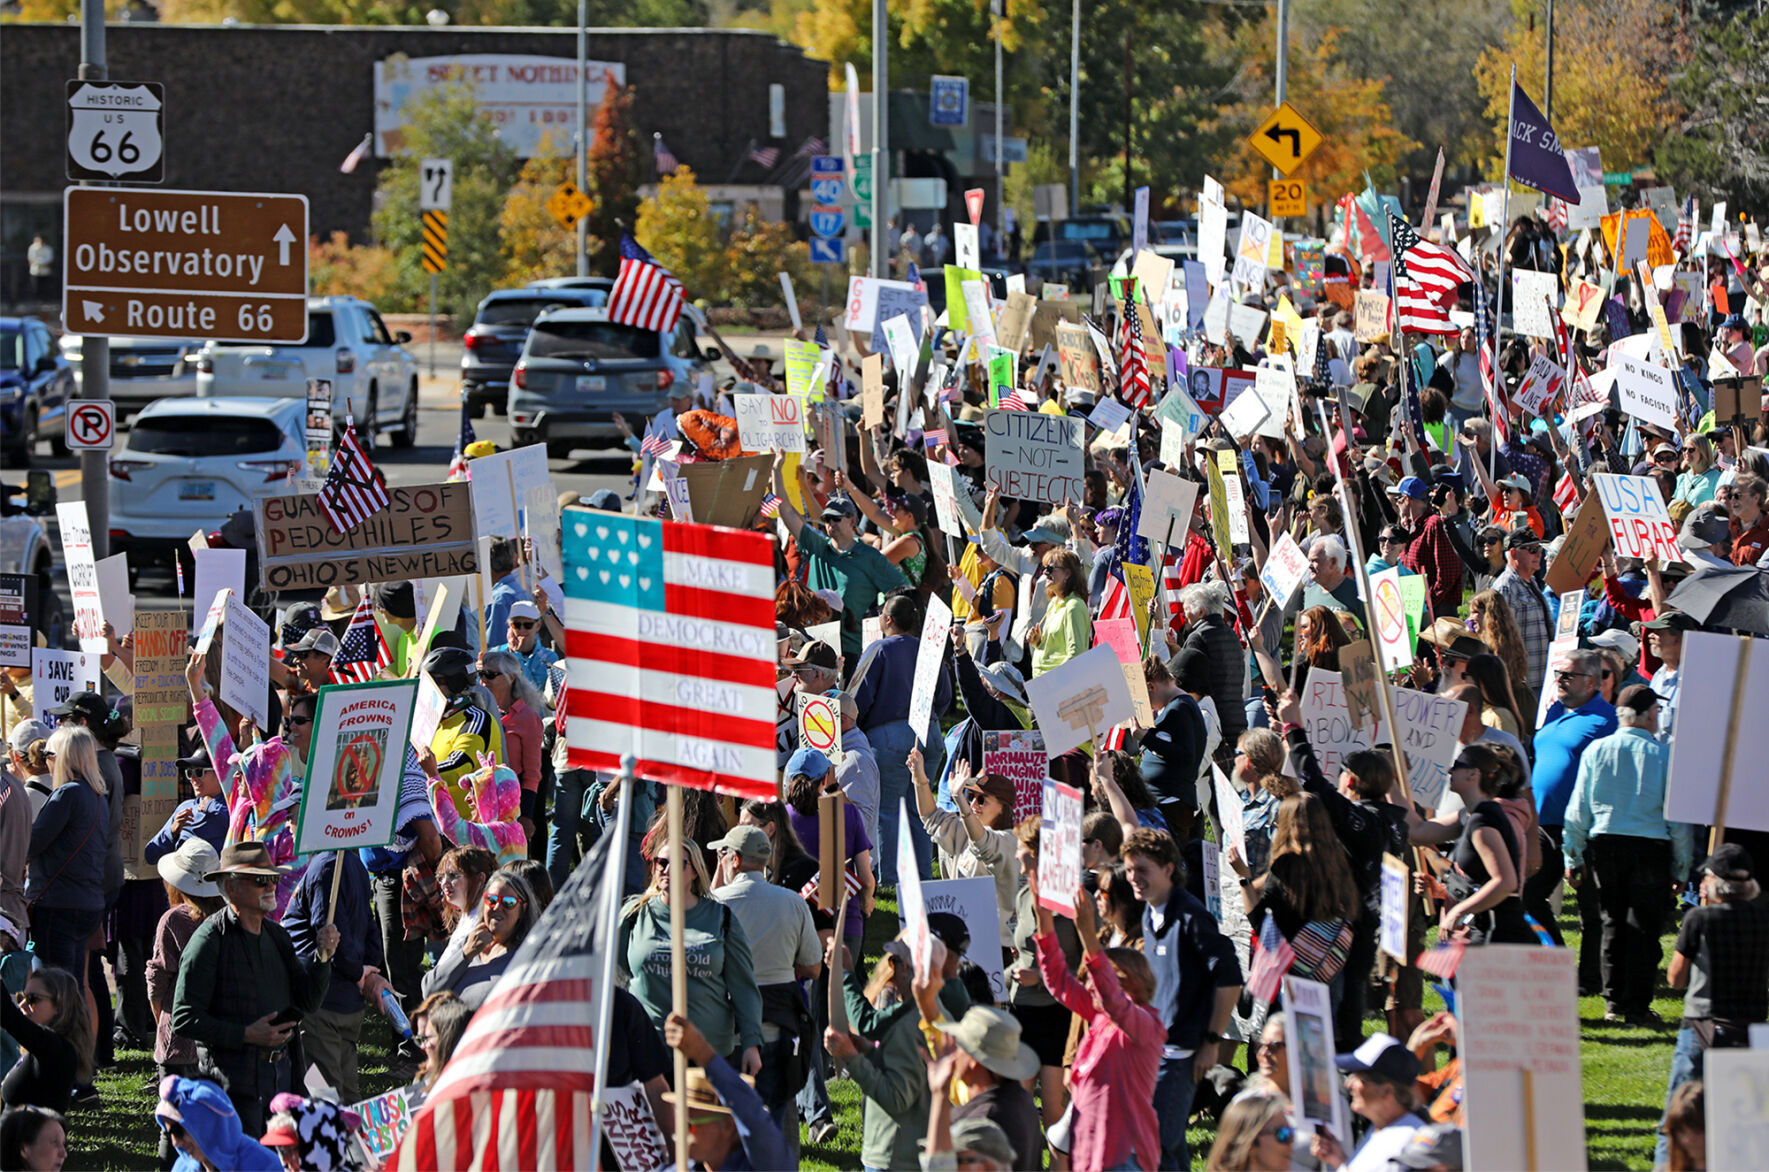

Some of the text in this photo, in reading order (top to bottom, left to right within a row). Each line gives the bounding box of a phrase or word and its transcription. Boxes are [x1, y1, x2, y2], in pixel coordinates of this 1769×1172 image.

[87, 95, 144, 107] HISTORIC
[1512, 119, 1538, 143] ACK
[90, 130, 140, 164] 66
[813, 184, 842, 201] 40
[1273, 183, 1302, 200] 20
[119, 204, 221, 235] Lowell
[818, 213, 836, 230] 17
[76, 243, 264, 285] Observatory
[127, 301, 274, 332] Route 66
[1532, 357, 1551, 380] HOLD
[1625, 363, 1664, 385] NO KINGS
[740, 398, 797, 421] SAY NO
[1626, 388, 1671, 414] NO FACISTS
[742, 432, 803, 449] OLIGARCHY
[987, 413, 1079, 450] CITIZENS
[988, 467, 1082, 505] SUBJECTS
[1599, 476, 1662, 514] USA
[269, 515, 451, 553] PEDOPHILES
[1611, 518, 1683, 562] FUBAR
[269, 561, 359, 588] OHIO'S
[423, 552, 476, 574] FLAG
[684, 559, 742, 588] MAKE
[136, 613, 151, 628] KEEP
[153, 613, 168, 628] YOUR
[638, 613, 765, 652] DEMOCRACY
[135, 630, 187, 657] HANDS OFF
[48, 660, 74, 681] SAVE
[54, 686, 70, 703] OUR
[677, 680, 742, 711] GREAT
[1312, 682, 1349, 711] RIS
[339, 700, 396, 718] AMERICA
[799, 696, 840, 720] NO FAUX
[1395, 691, 1459, 736] POWER
[338, 714, 393, 730] FROWNS
[1405, 729, 1438, 749] AND
[679, 737, 743, 770] AGAIN
[985, 751, 1047, 768] NORMALIZE
[143, 761, 177, 777] OUR JOBS
[985, 765, 1046, 780] CHANGING
[344, 810, 355, 820] on
[324, 819, 373, 839] CROWNS!
[1040, 862, 1079, 895] AMERICA
[648, 951, 711, 965] Fro Old
[686, 967, 713, 977] Men
[354, 1094, 401, 1131] KINGS
